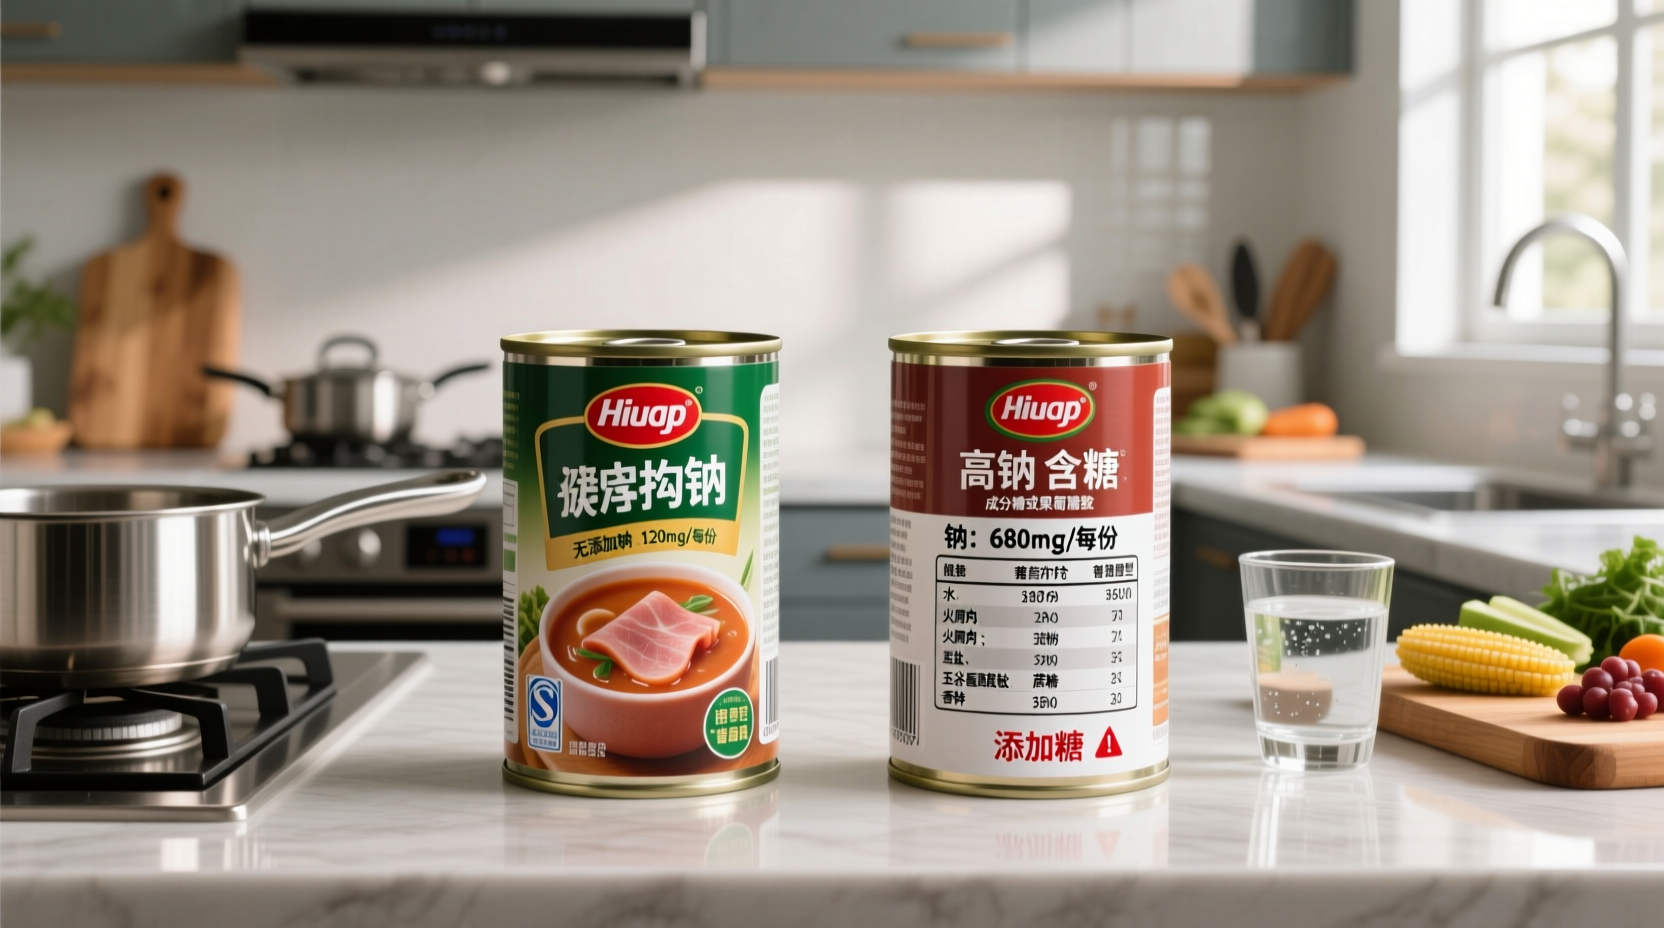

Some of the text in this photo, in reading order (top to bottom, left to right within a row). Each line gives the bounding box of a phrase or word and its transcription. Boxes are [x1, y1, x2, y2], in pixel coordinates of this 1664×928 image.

[959, 449, 1035, 491] 高钠
[1044, 448, 1119, 490] 含糖
[993, 729, 1084, 762] 添加糖
